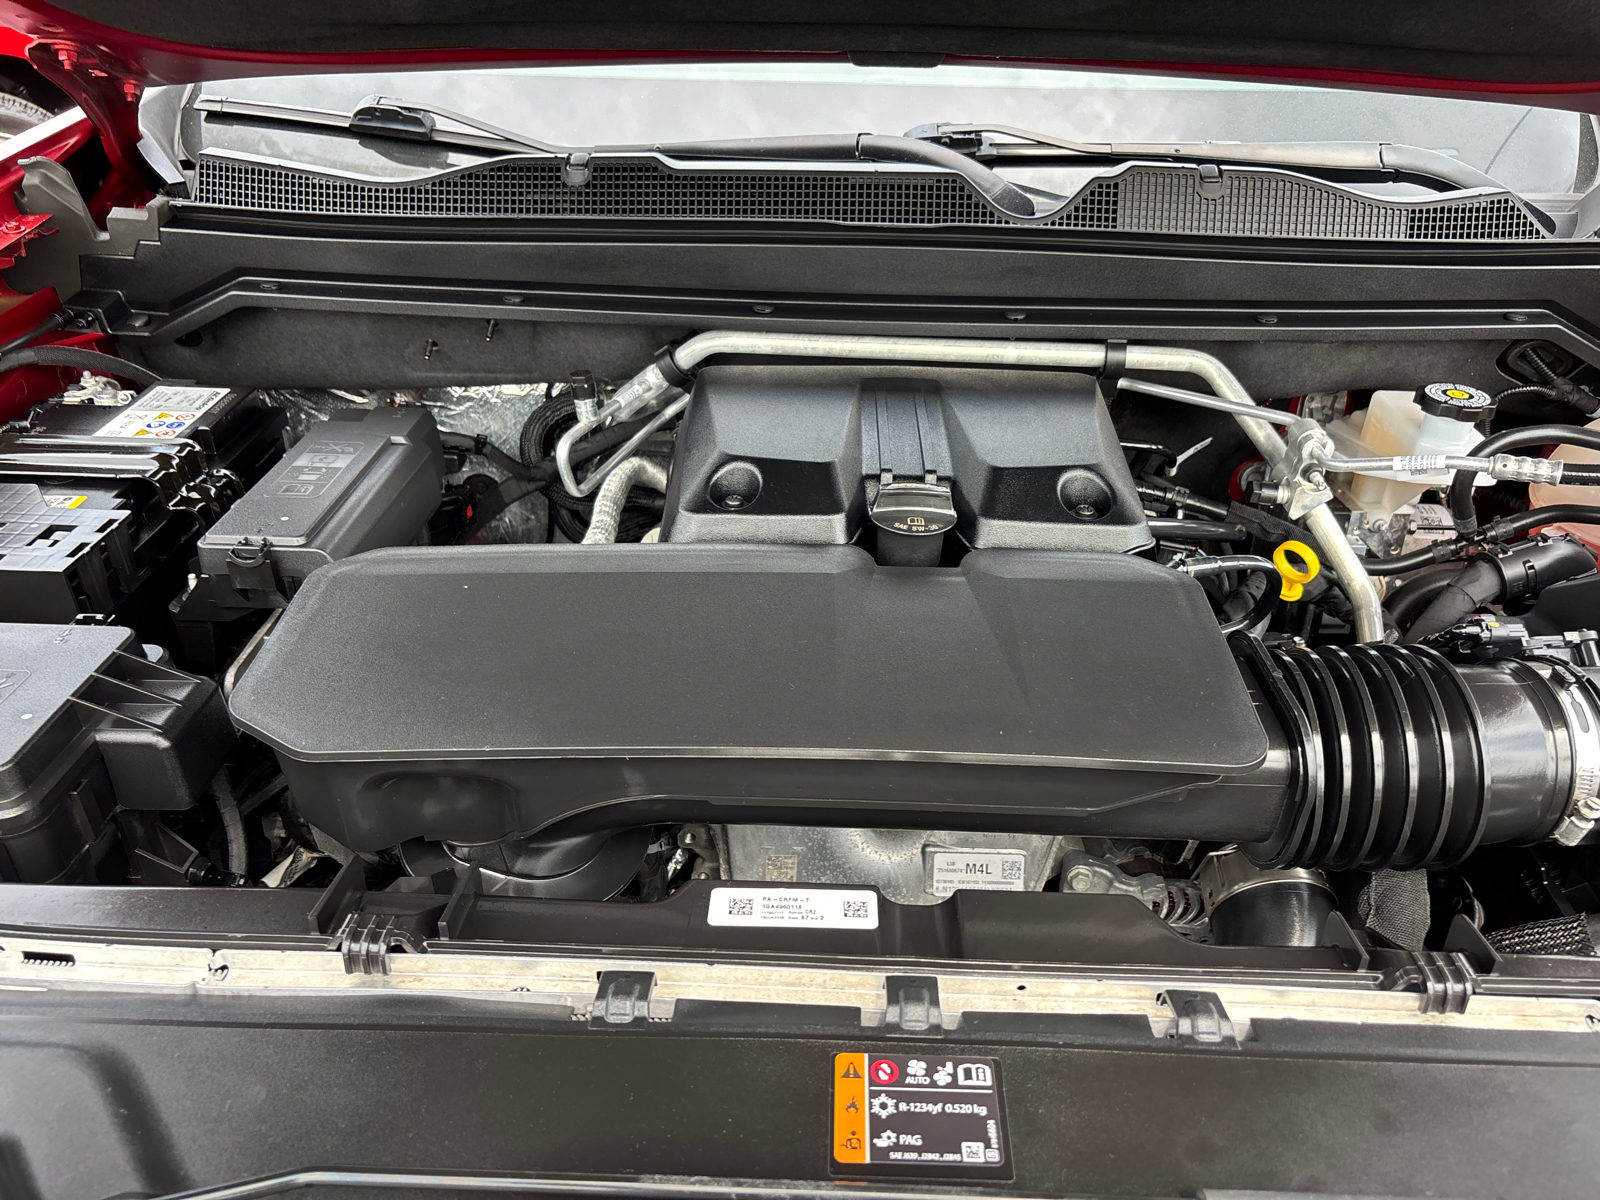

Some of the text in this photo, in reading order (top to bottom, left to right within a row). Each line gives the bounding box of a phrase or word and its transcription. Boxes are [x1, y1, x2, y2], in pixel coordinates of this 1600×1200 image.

[965, 863, 992, 875] M4L
[905, 1076, 930, 1085] AUTO
[898, 1102, 988, 1116] R-1234yf 0.520 kg
[899, 1134, 923, 1146] PAG
[889, 1152, 902, 1160] SAE
